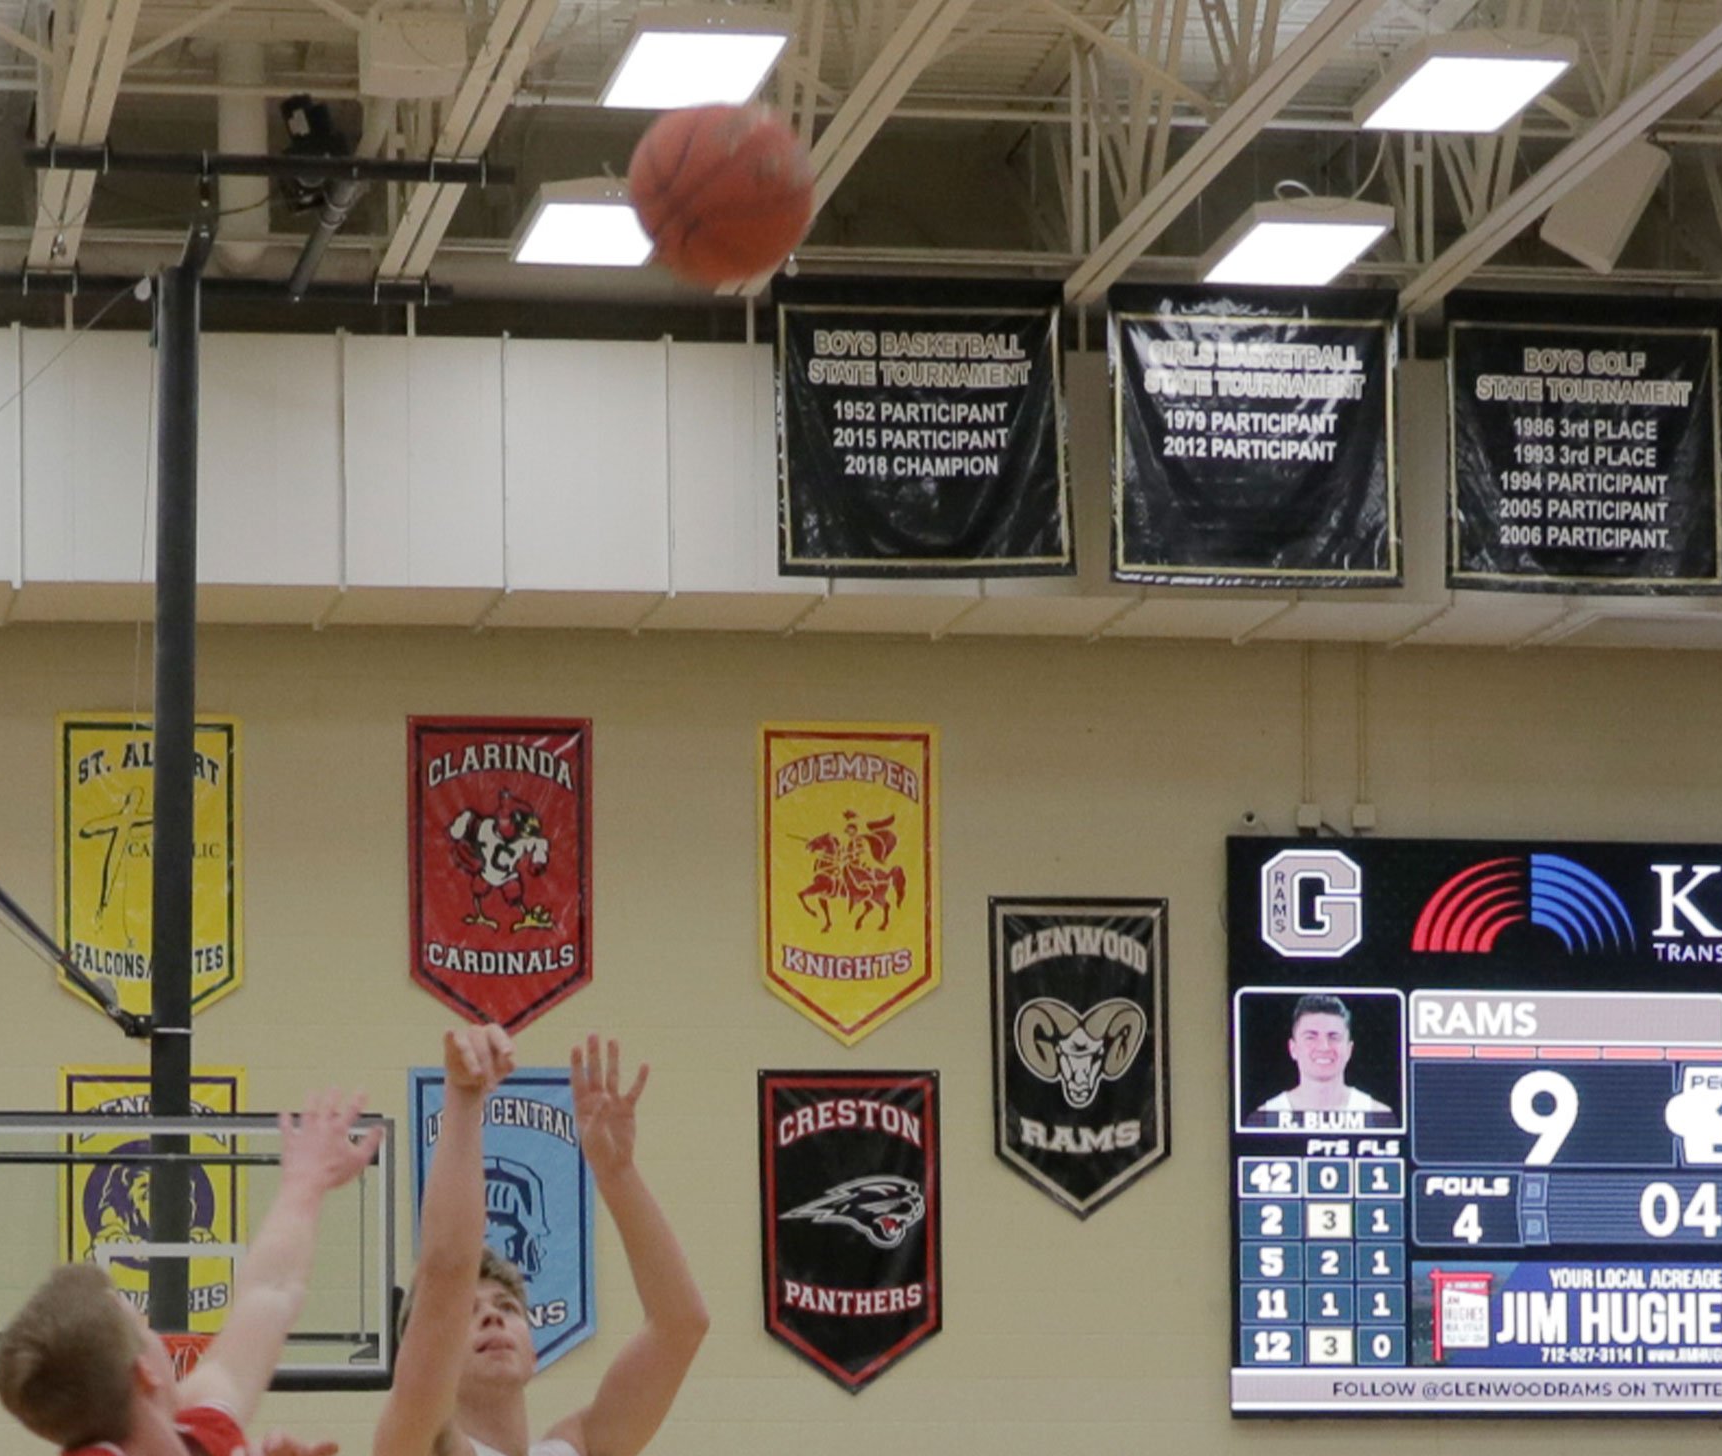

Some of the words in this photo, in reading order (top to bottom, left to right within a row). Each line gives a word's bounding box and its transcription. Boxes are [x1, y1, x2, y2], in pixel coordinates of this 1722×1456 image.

[814, 331, 876, 356] BOYS
[880, 332, 1025, 358] BASKETBALL
[809, 358, 876, 385] STATE
[880, 360, 1031, 388] TOURNAMENT
[1524, 349, 1586, 374] BOYS
[1589, 351, 1646, 376] GOLF
[1476, 376, 1543, 401] STATE
[1547, 378, 1692, 407] TOURNAMENT
[833, 402, 875, 421] 1952
[880, 402, 1008, 423] PARTICIPANT
[1164, 410, 1206, 431] 1979
[1210, 411, 1337, 435] PARTICIPANT
[833, 428, 875, 448] 2015
[880, 428, 1008, 450] PARTICIPANT
[1513, 419, 1556, 438] 1986
[1560, 419, 1589, 439] 3rd
[1594, 420, 1657, 441] PLACE
[1162, 437, 1206, 457] 2012
[1210, 438, 1337, 461] PARTICIPANT
[1513, 445, 1556, 465] 1993
[1560, 445, 1589, 466] 3rd
[1594, 446, 1657, 468] PLACE
[844, 455, 887, 475] 2018
[892, 456, 999, 477] CHAMPION
[1500, 472, 1542, 492] 1994
[1547, 472, 1668, 495] PARTICIPANT
[1500, 499, 1542, 519] 2005
[1547, 499, 1668, 522] PARTICIPANT
[1500, 526, 1542, 545] 2006
[1547, 526, 1668, 549] PARTICIPANT
[78, 749, 111, 786] ST.
[429, 744, 573, 791] CLARINDA
[777, 753, 918, 803] KUEMPER
[1261, 850, 1362, 957] G
[1274, 871, 1287, 933] RAMS
[428, 943, 574, 975] CARDINALS
[782, 945, 912, 980] KNIGHTS
[1010, 926, 1147, 975] GLENWOOD
[1419, 1002, 1536, 1035] RAMS
[489, 1097, 576, 1146] CENTRAL
[779, 1100, 921, 1147] CRESTON
[1278, 1113, 1298, 1128] R.
[1304, 1113, 1365, 1128] BLUM
[1510, 1070, 1578, 1165] 9
[1020, 1117, 1141, 1153] RAMS
[1307, 1140, 1349, 1156] PTS
[1358, 1140, 1399, 1156] FLS
[1250, 1164, 1292, 1192] 42
[1426, 1178, 1510, 1196] FOULS
[1261, 1206, 1283, 1233] 2
[1453, 1204, 1482, 1243] 4
[1261, 1248, 1283, 1276] 5
[1549, 1269, 1595, 1289] YOUR
[1599, 1269, 1646, 1290] LOCAL
[785, 1281, 922, 1315] PANTHERS
[1257, 1291, 1287, 1318] 11
[1497, 1291, 1567, 1345] JIM
[1254, 1332, 1291, 1360] 12
[1333, 1382, 1415, 1397] FOLLOW
[1423, 1381, 1612, 1399] @GLENWOODRAMS
[1618, 1382, 1646, 1397] ON
